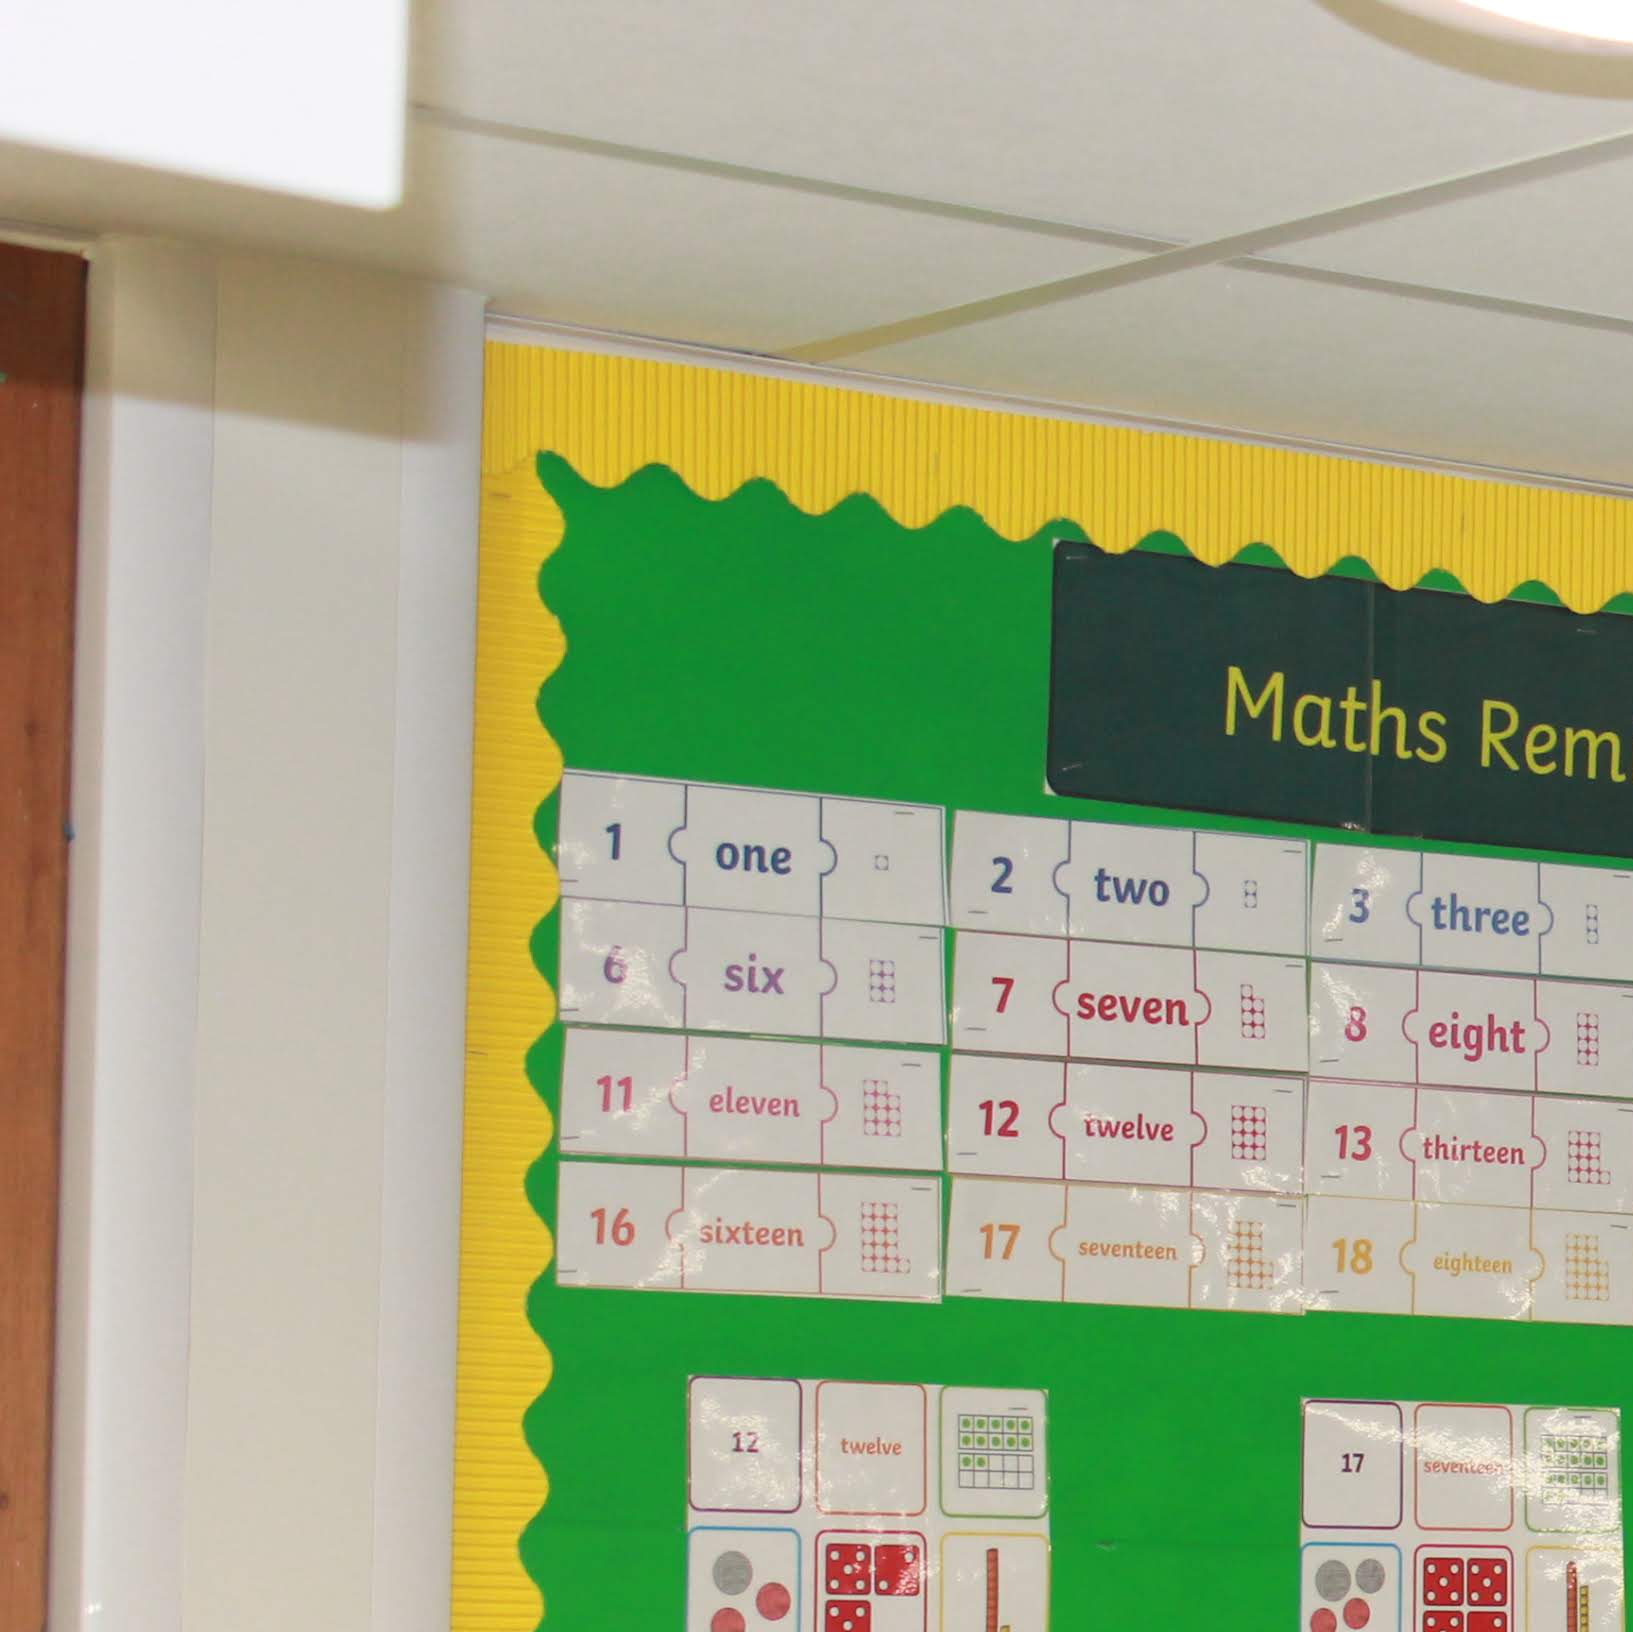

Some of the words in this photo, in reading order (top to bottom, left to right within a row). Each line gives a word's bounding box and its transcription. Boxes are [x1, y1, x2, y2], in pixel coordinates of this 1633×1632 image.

[1225, 666, 1447, 763] Maths
[605, 823, 621, 859] 1
[715, 839, 791, 874] one
[991, 857, 1012, 892] 2
[1094, 869, 1169, 906] two
[1349, 888, 1370, 923] 3
[1431, 894, 1530, 937] three
[604, 946, 625, 983] 6
[724, 954, 784, 995] six
[991, 977, 1014, 1013] 7
[1077, 989, 1188, 1026] seven
[1344, 1007, 1366, 1041] 8
[1429, 1012, 1525, 1061] eight
[597, 1076, 634, 1112] 11
[709, 1084, 799, 1118] eleven
[979, 1101, 1019, 1137] 12
[1082, 1112, 1174, 1143] twelve
[1335, 1126, 1371, 1161] 13
[1423, 1135, 1524, 1165] thirteen
[590, 1208, 635, 1246] 16
[700, 1215, 804, 1249] sixteen
[980, 1224, 1020, 1260] 17
[1079, 1237, 1177, 1261] seventeen
[1332, 1239, 1372, 1274] 18
[1433, 1252, 1512, 1277] eighteen
[732, 1432, 759, 1454] 12
[841, 1436, 902, 1457] twelve
[1341, 1452, 1364, 1474] 17
